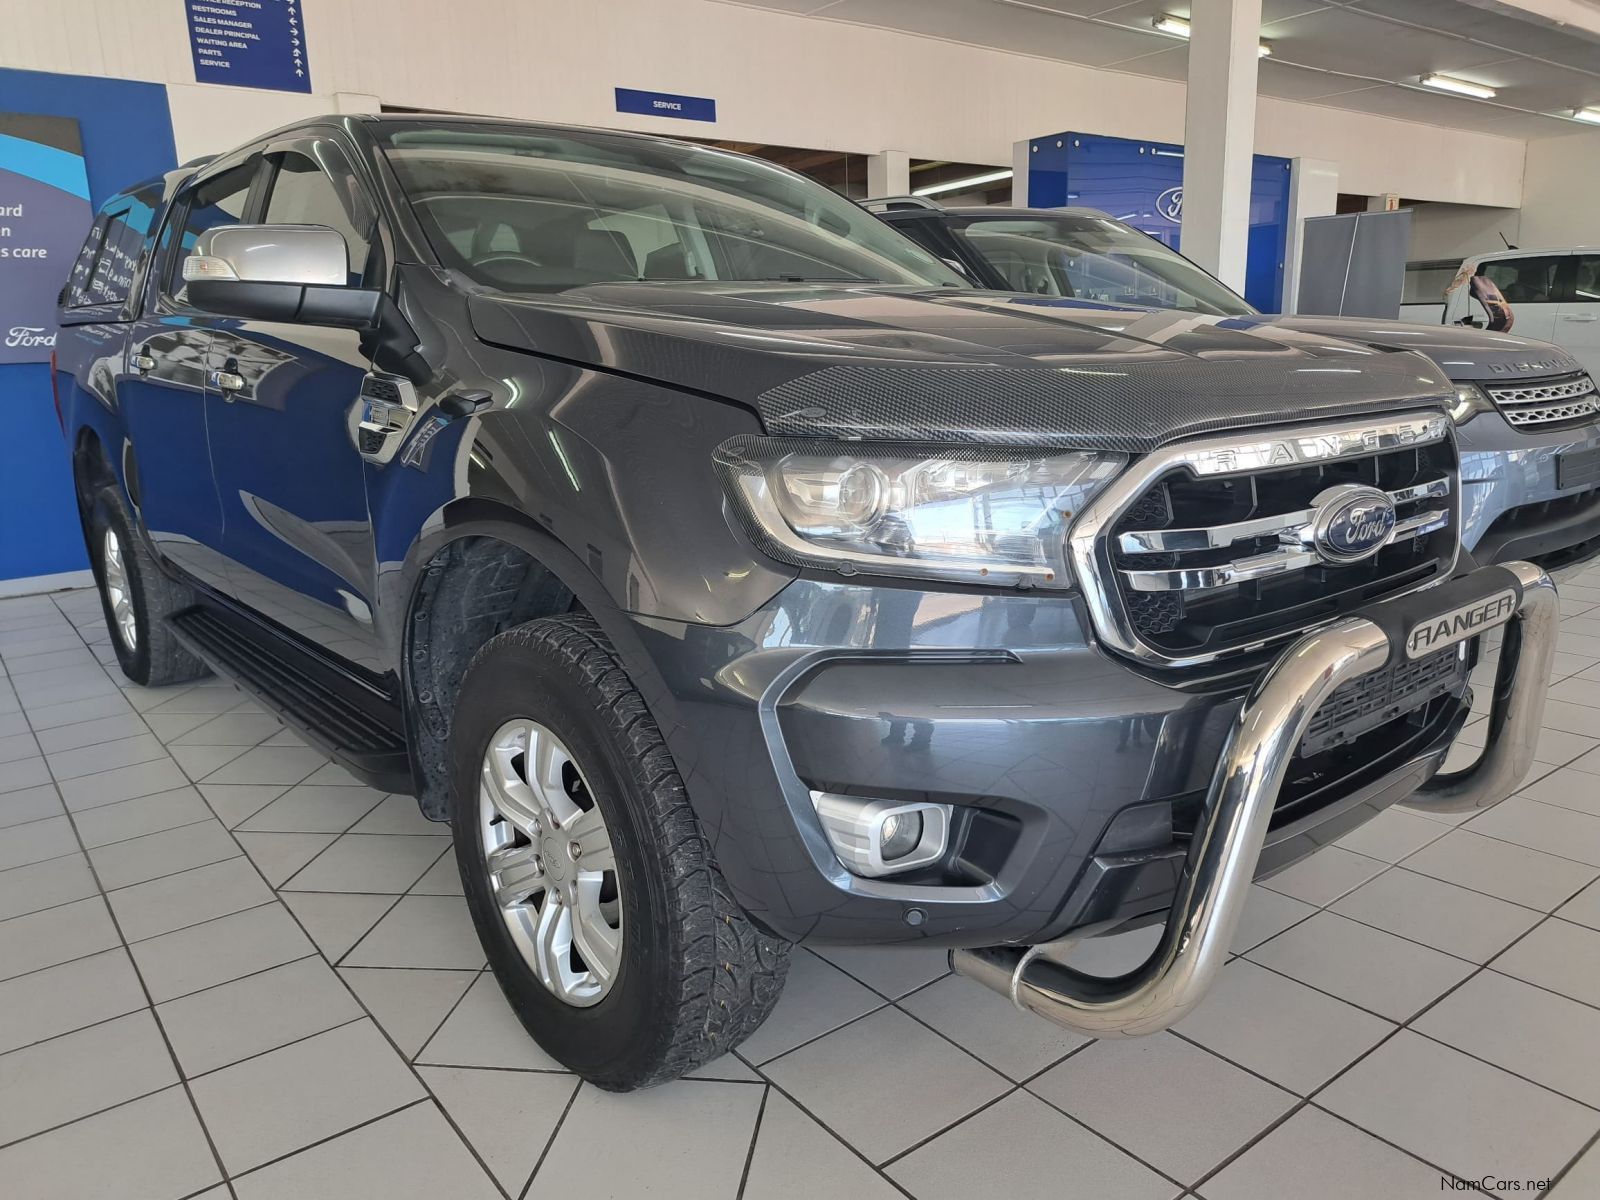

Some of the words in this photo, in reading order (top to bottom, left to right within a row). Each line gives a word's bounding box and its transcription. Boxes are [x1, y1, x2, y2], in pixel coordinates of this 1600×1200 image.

[192, 5, 237, 15] RESTROOMS
[193, 15, 216, 24] SALES
[217, 19, 252, 29] MANAGER
[195, 26, 223, 36] DEALER
[223, 30, 260, 41] PRINCIPAL
[196, 37, 228, 47] WAITING
[228, 41, 248, 49] AREA
[198, 48, 222, 57] PARTS
[200, 59, 230, 68] SERVICE
[653, 100, 681, 110] SERVICE
[12, 247, 48, 258] care
[5, 326, 58, 347] Ford
[1214, 419, 1448, 472] RANGER
[1345, 503, 1388, 544] Ford
[1412, 594, 1513, 651] RANGER
